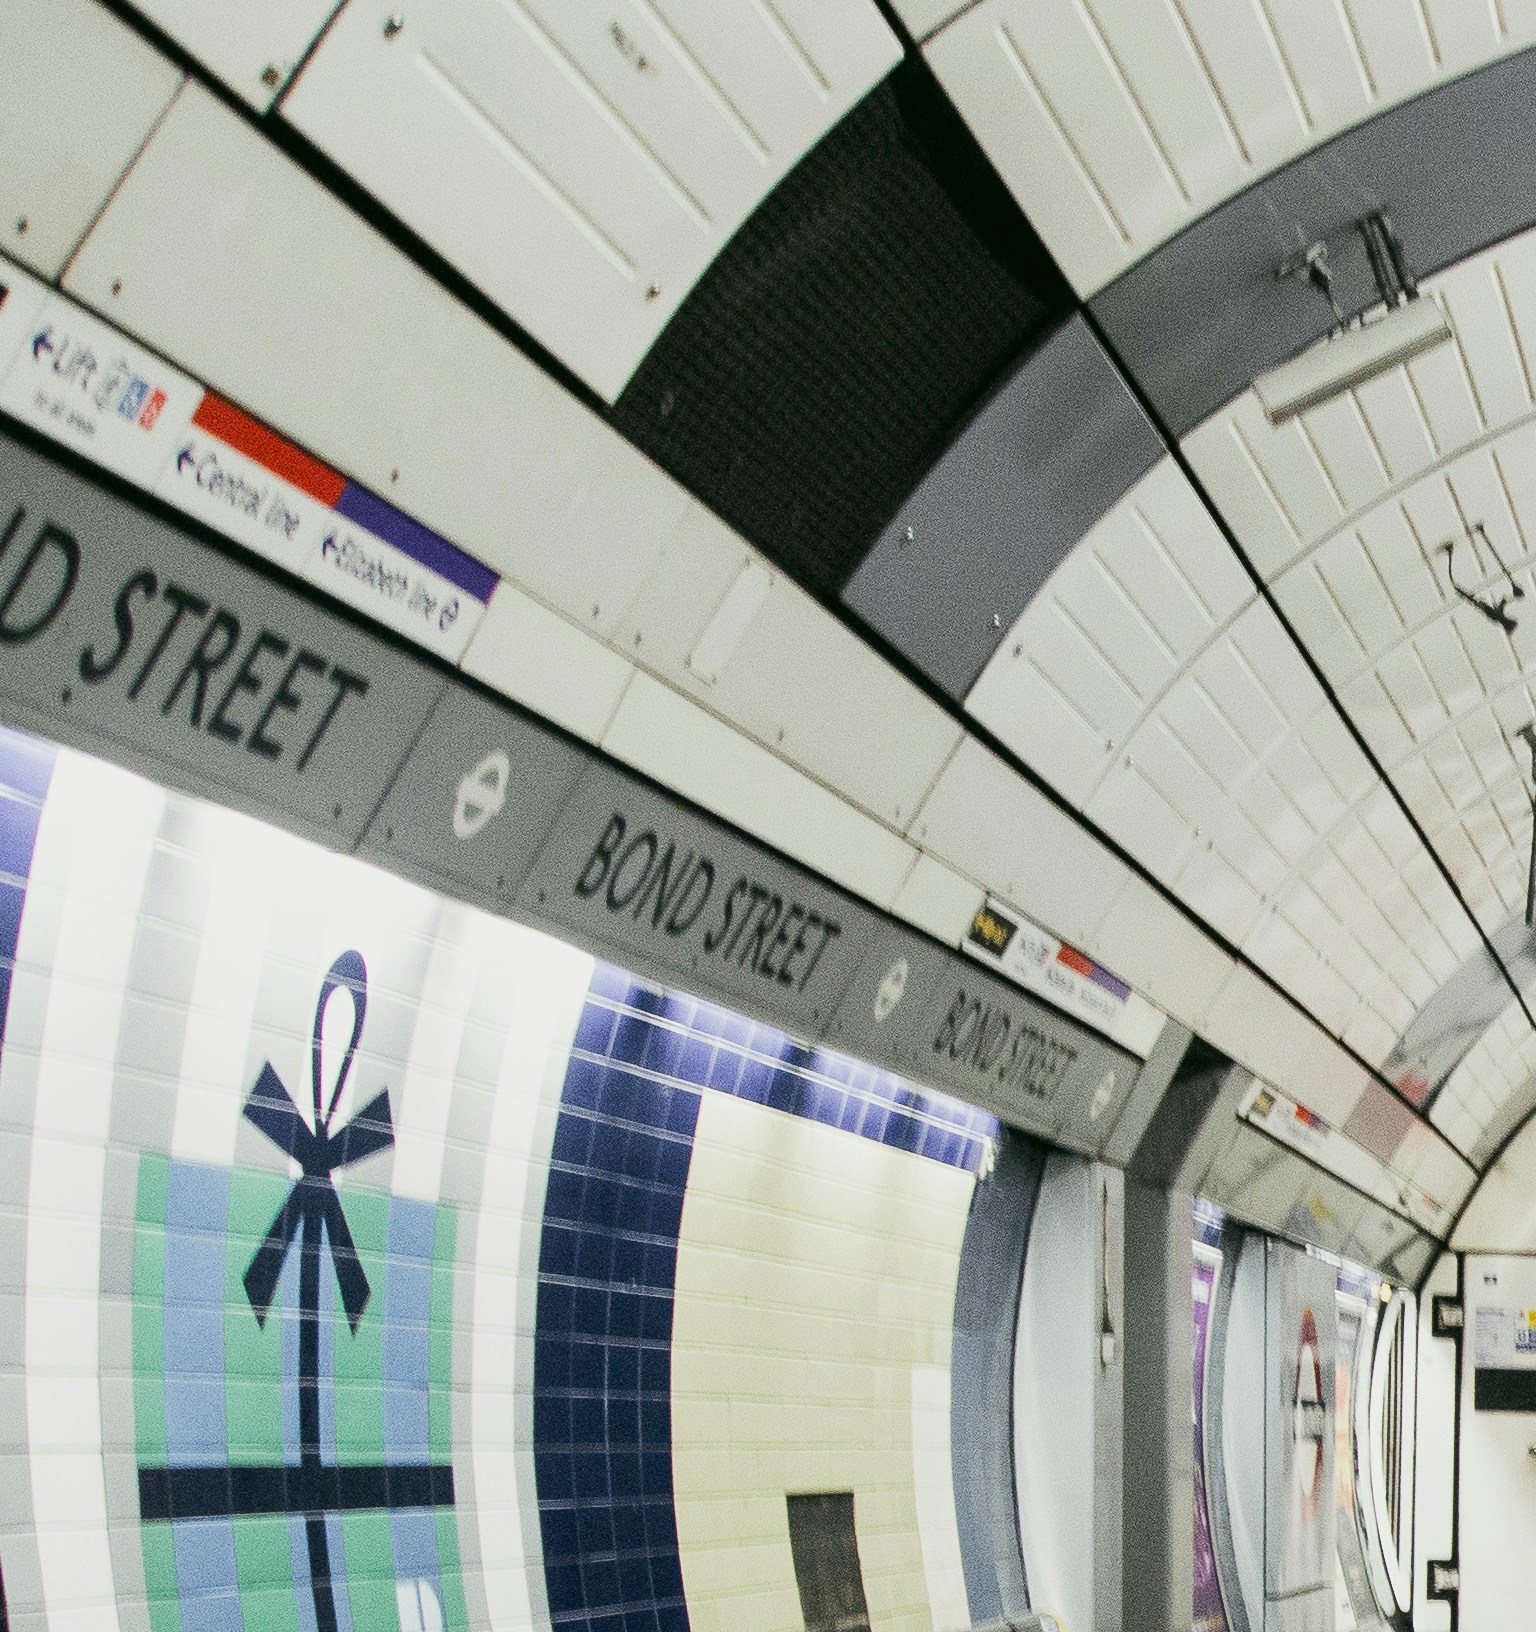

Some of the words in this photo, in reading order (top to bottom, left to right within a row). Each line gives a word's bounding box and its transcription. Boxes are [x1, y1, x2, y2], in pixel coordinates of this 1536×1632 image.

[197, 451, 268, 520] Central
[79, 567, 371, 771] STREET
[574, 813, 716, 938] BOND
[703, 878, 841, 992] STREET
[933, 990, 1011, 1073] BOND
[999, 1026, 1078, 1102] STREET
